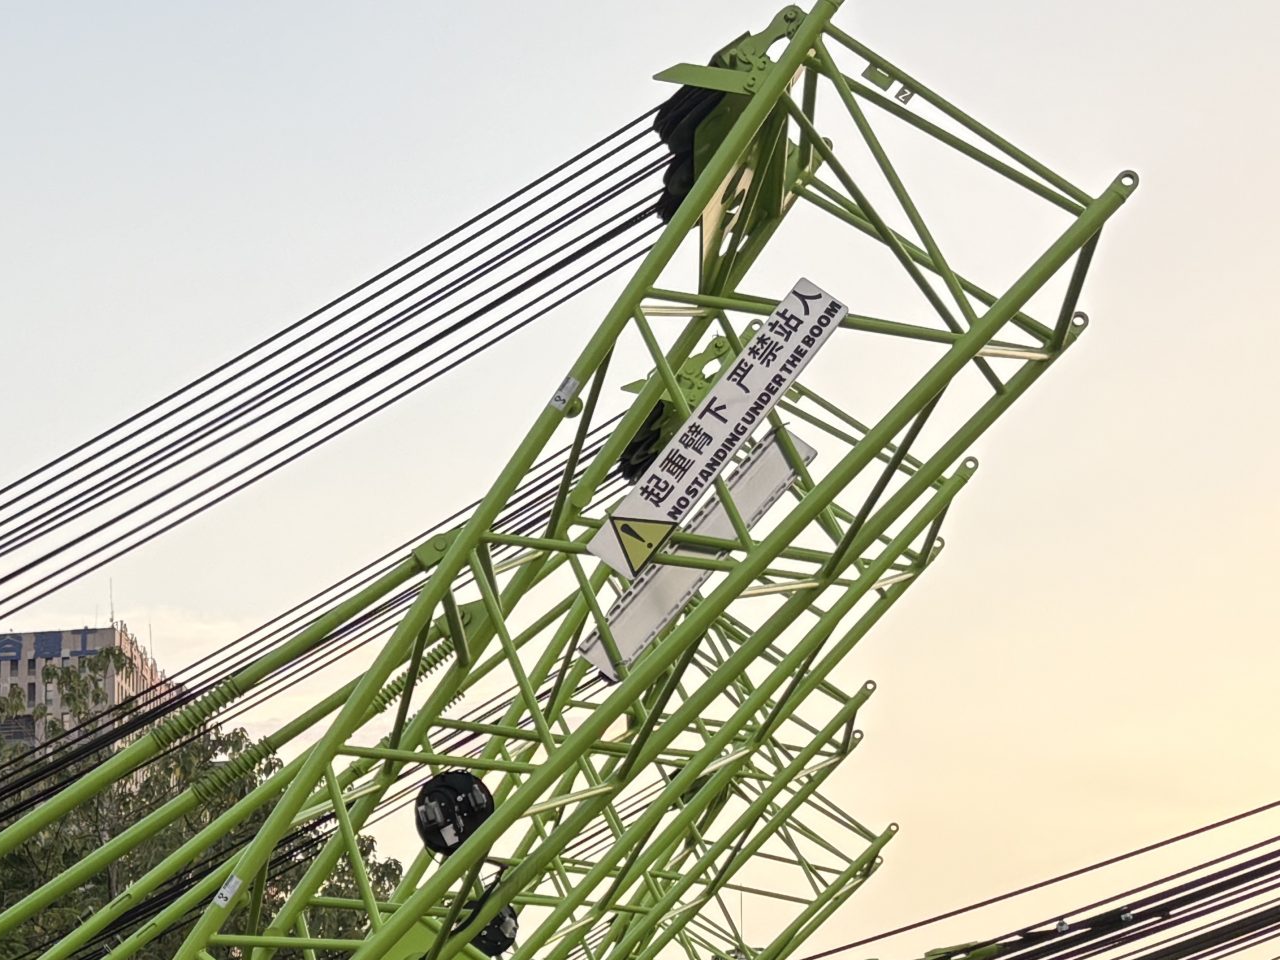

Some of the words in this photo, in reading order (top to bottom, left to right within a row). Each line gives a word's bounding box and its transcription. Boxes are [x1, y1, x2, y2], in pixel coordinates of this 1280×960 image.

[639, 395, 729, 508] 起重臂下
[725, 289, 823, 395] 严禁站人
[666, 496, 690, 521] NO
[684, 422, 749, 499] STANDING
[741, 373, 787, 426] UNDER
[778, 344, 809, 375] THE
[800, 299, 842, 349] BOOM
